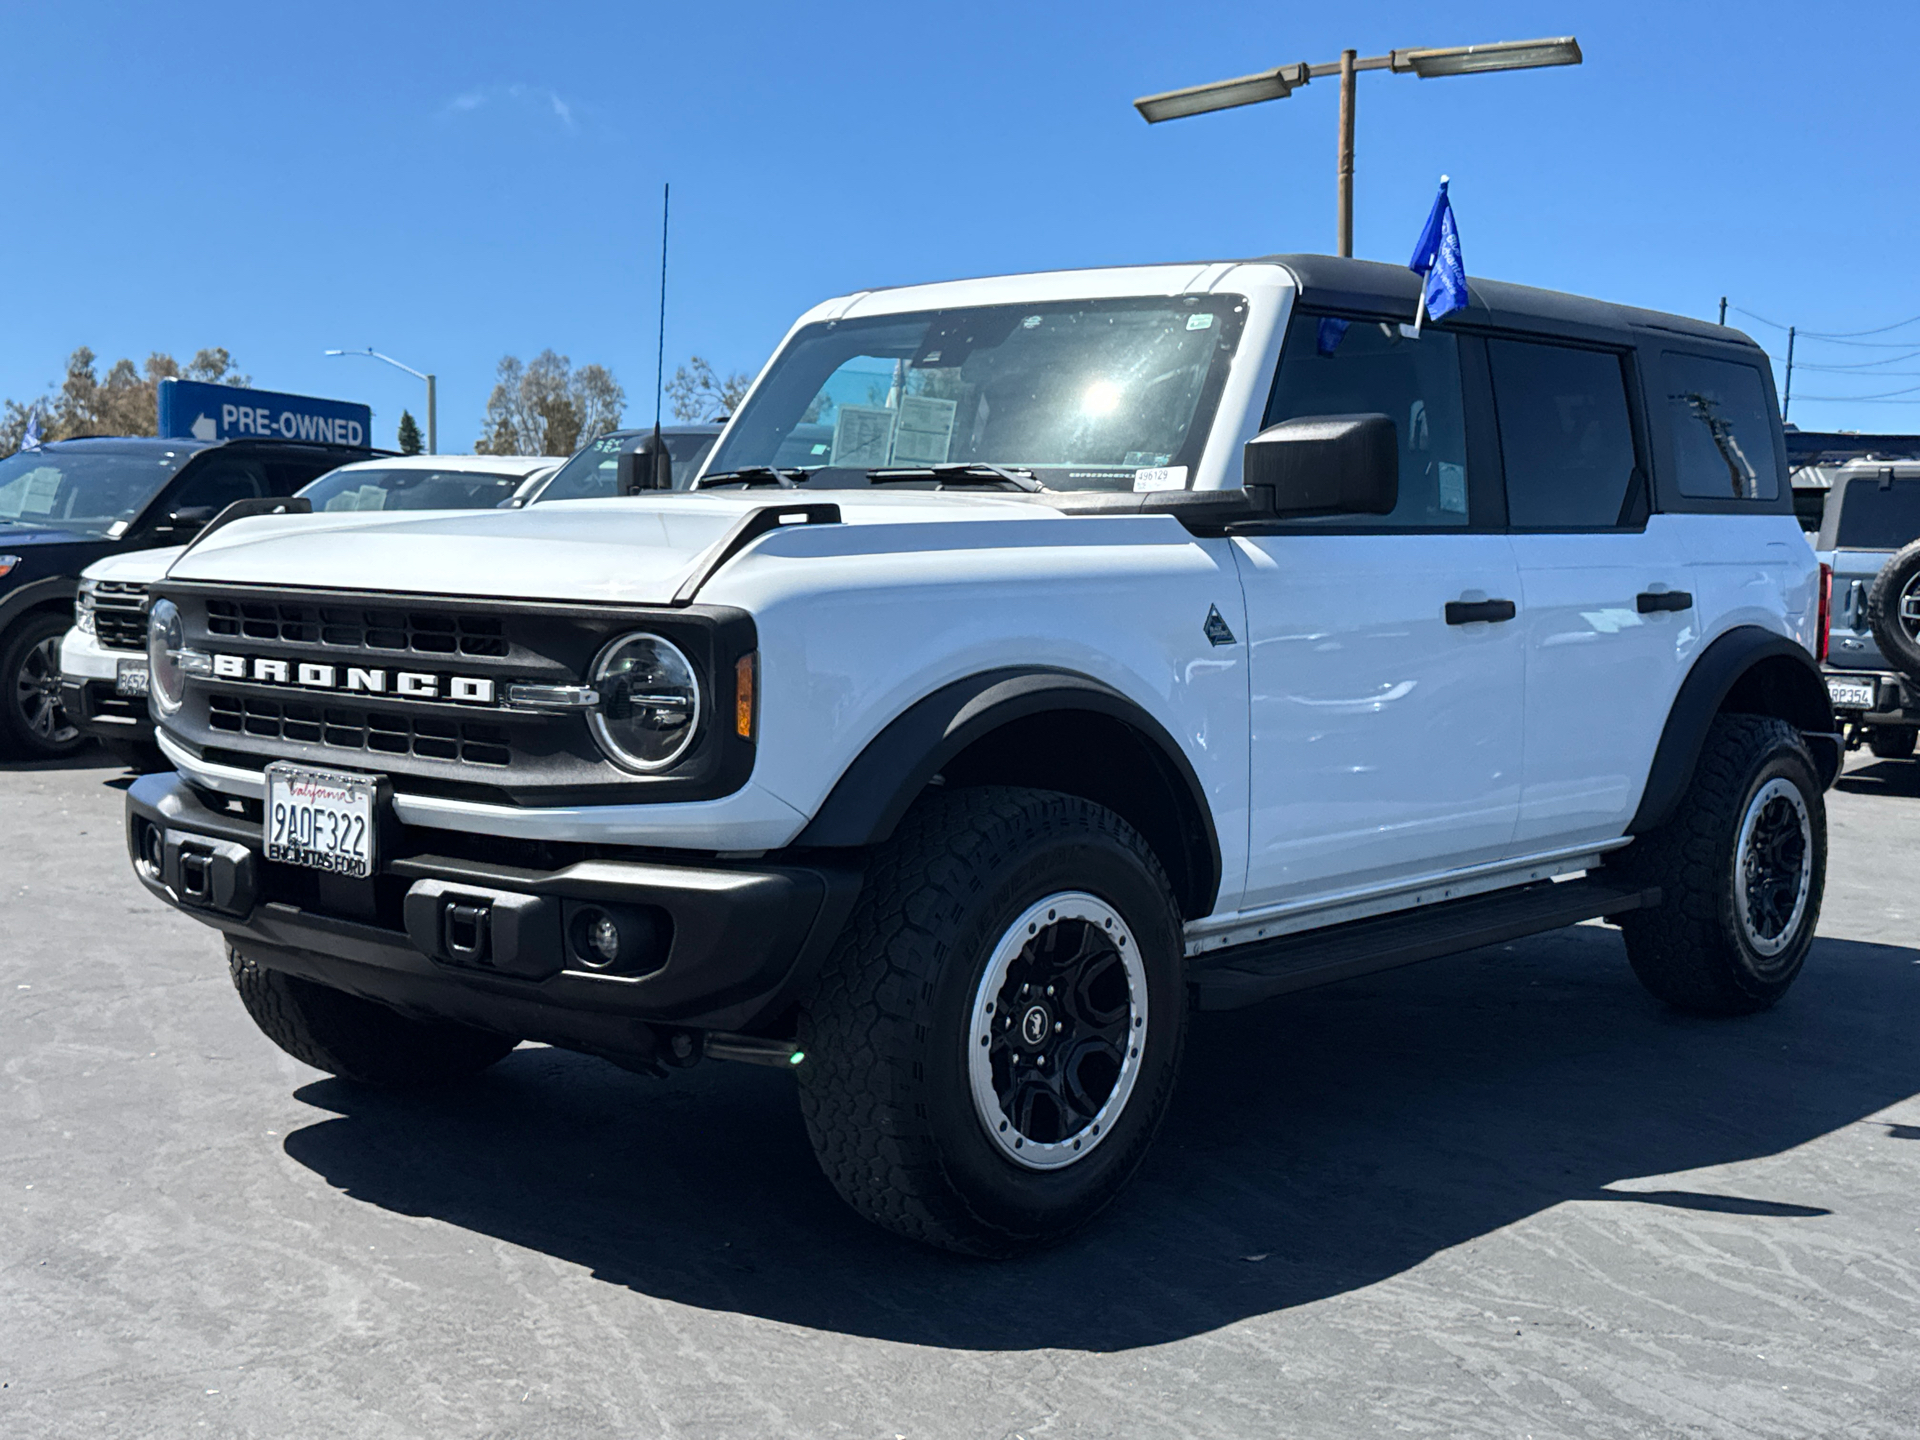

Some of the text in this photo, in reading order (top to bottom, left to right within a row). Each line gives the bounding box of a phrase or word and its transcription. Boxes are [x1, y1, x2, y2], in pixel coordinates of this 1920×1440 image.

[222, 404, 363, 446] PRE-OWNED
[214, 654, 495, 702] BRONCO
[335, 854, 366, 877] FORD
